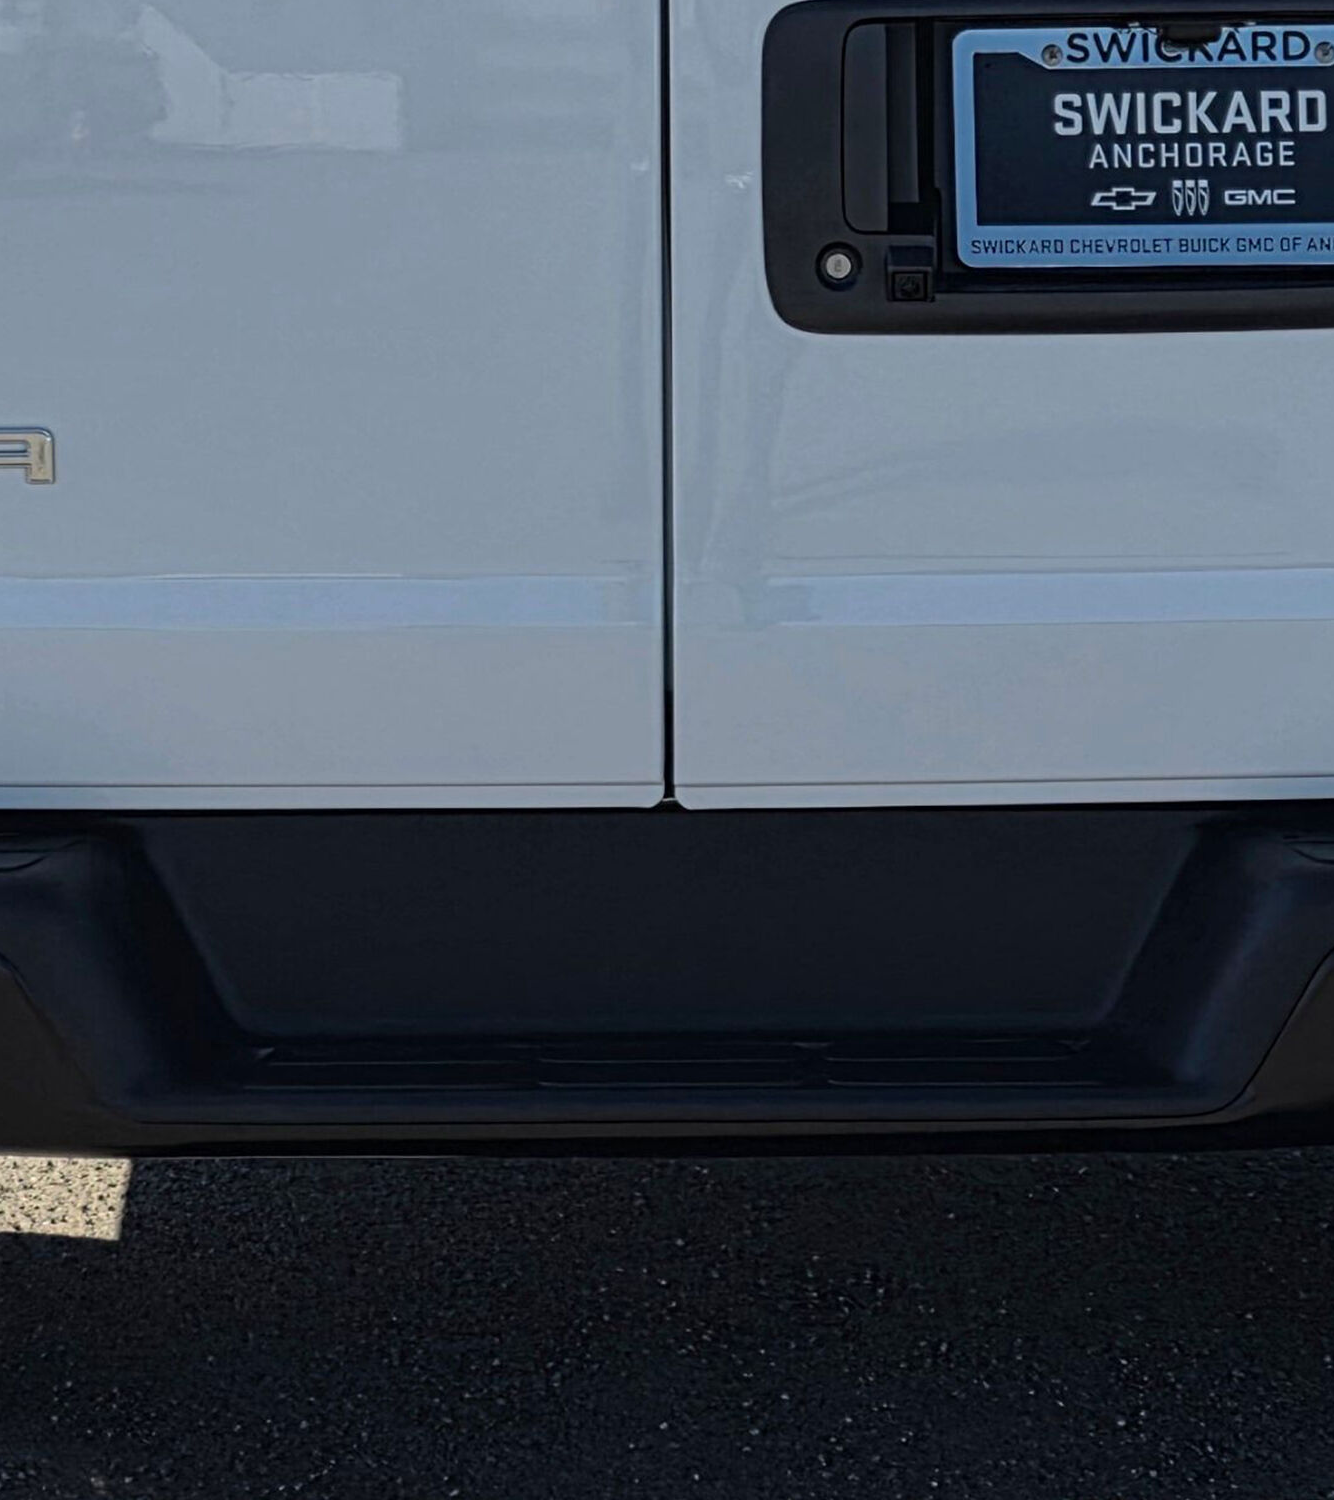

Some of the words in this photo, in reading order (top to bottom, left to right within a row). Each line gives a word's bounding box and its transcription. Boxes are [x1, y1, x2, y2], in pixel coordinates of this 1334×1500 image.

[1053, 89, 1327, 136] SWICKARD
[1088, 140, 1296, 169] ANCHORAGE
[1223, 189, 1296, 206] GMC
[970, 238, 1065, 255] SWICKARD
[1069, 238, 1174, 255] CHEVROLET
[1178, 237, 1231, 253] BUICK
[1235, 237, 1274, 253] GMC
[1279, 236, 1303, 252] OF
